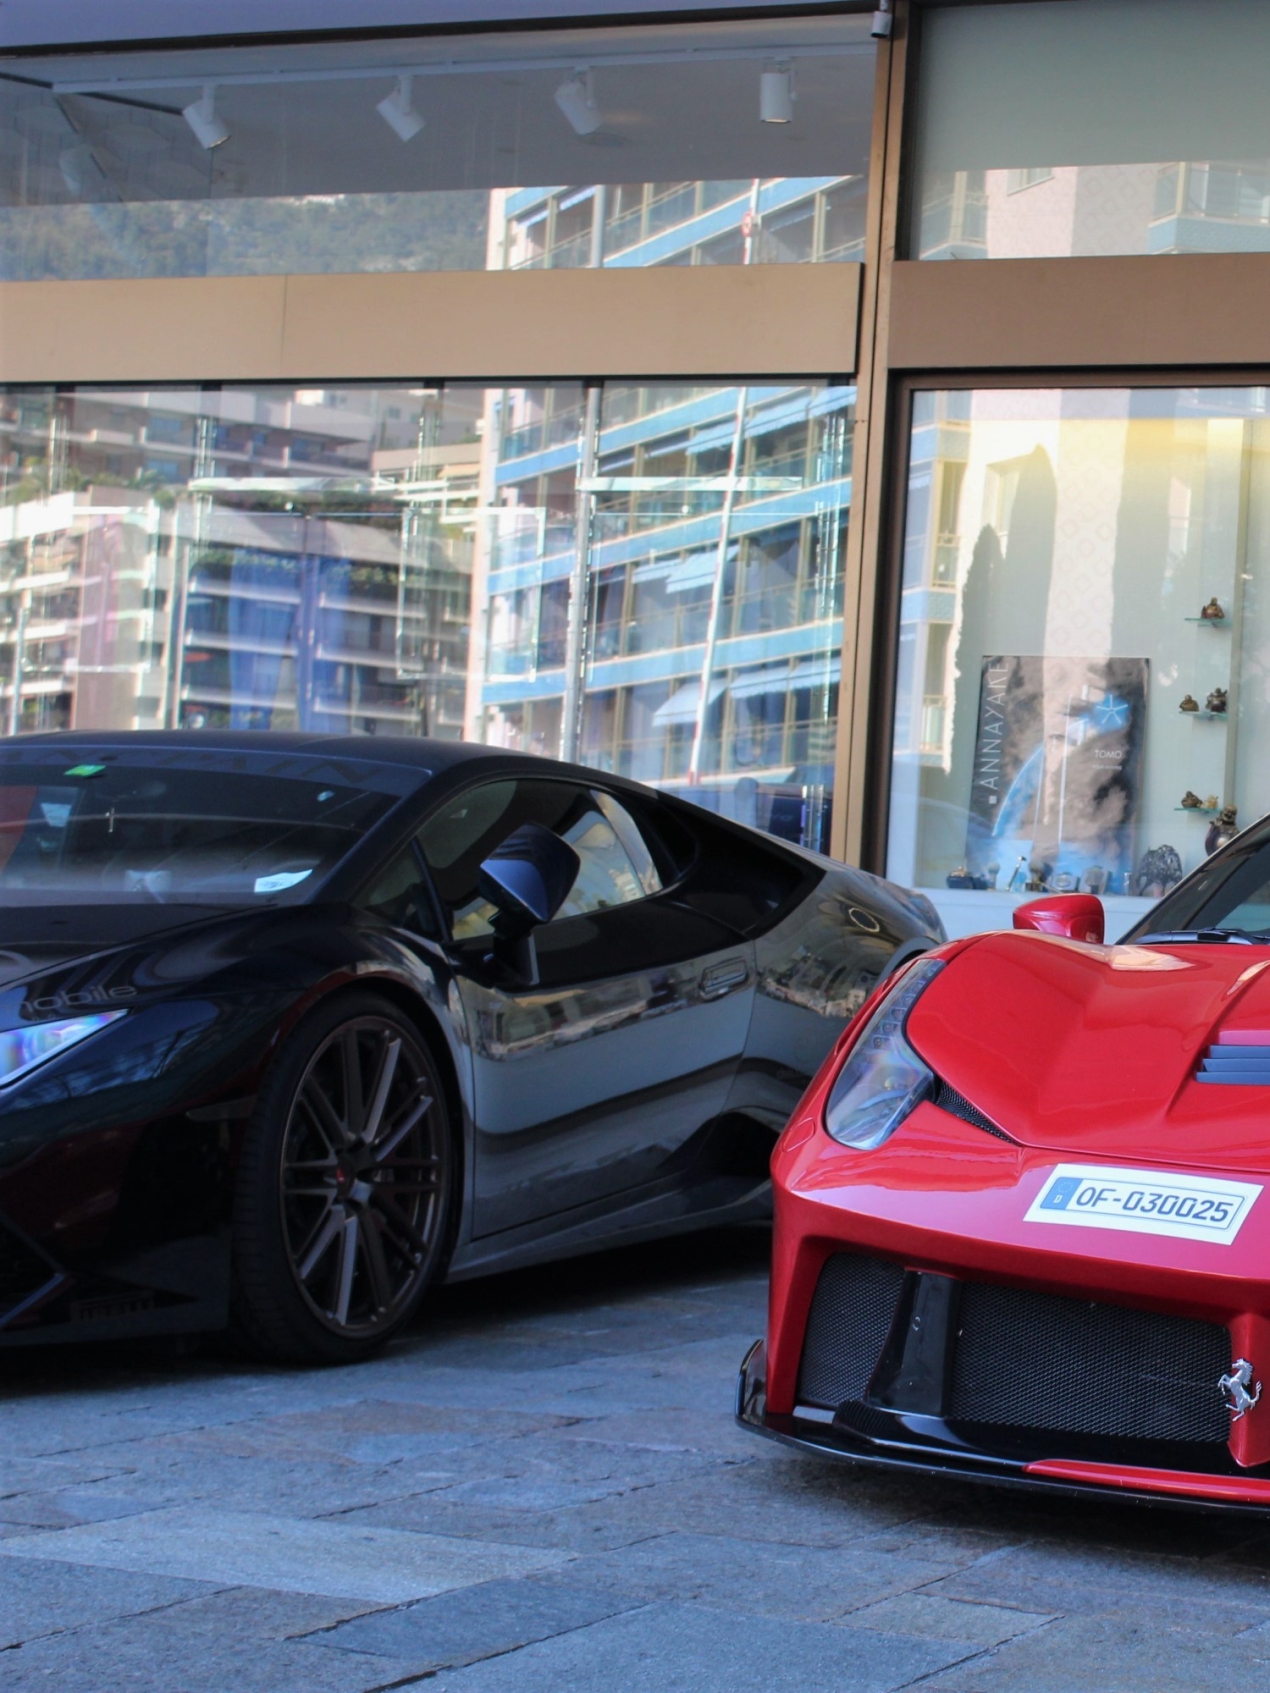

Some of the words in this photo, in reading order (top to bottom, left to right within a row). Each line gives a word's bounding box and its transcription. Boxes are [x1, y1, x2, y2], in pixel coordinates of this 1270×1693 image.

[980, 663, 1008, 790] ANNAYAKE
[1095, 750, 1122, 759] TOMO
[1053, 1195, 1063, 1204] D
[1076, 1186, 1234, 1222] OF-030025
